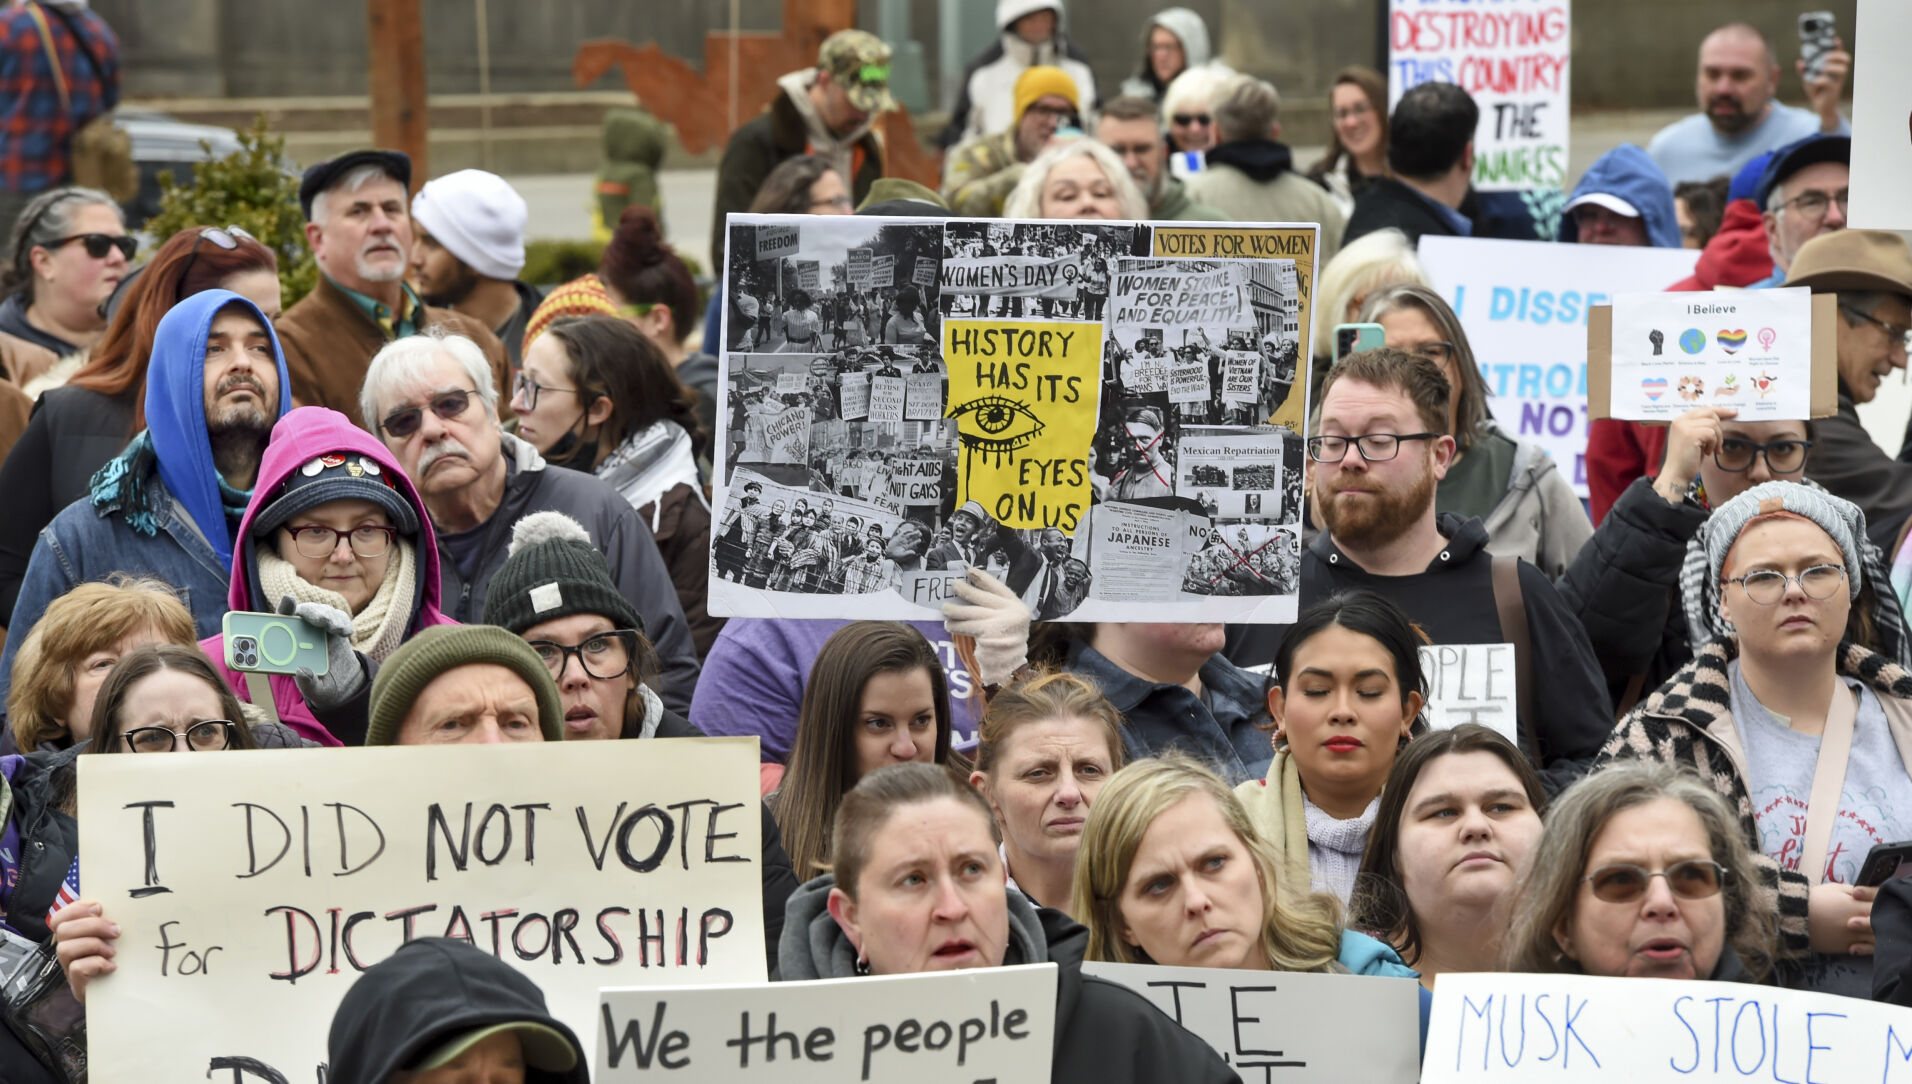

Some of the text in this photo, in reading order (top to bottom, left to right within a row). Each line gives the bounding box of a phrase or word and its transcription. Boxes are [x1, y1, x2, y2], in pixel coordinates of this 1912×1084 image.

[1391, 8, 1566, 51] DESTROYING
[1459, 53, 1568, 94] COUNTRY
[1494, 102, 1549, 140] THE
[1474, 146, 1566, 187] NAIRES
[759, 233, 798, 252] FREEDOM
[1159, 234, 1311, 255] VOTES FOR WOMEN
[942, 264, 1018, 287] WOMEN'S
[1024, 264, 1058, 286] DAY
[1117, 271, 1230, 297] WOMEN STRIKE
[1135, 292, 1173, 306] FOR
[1694, 304, 1736, 315] Believe
[1117, 307, 1147, 323] AND
[951, 328, 1075, 358] HISTORY
[976, 361, 1082, 404] HAS ITS
[1170, 366, 1203, 377] SISTERHOOD
[1229, 367, 1253, 375] VIETNAM
[1239, 375, 1253, 383] OUR
[1226, 383, 1252, 392] SISTERS
[872, 396, 902, 404] SECOND
[766, 410, 805, 435] CHICANO
[869, 411, 899, 420] WORKERS
[1519, 402, 1588, 438] NO
[769, 421, 805, 445] POWER!
[1183, 446, 1280, 457] Mexican Repatriation
[915, 461, 941, 477] AIDS
[1019, 458, 1086, 488] EYES
[889, 482, 939, 499] NOT GAYS
[873, 496, 900, 516] FEAR
[996, 491, 1035, 522] ON
[1042, 503, 1081, 532] US
[1107, 532, 1171, 548] JAPANESE
[1189, 525, 1211, 538] NO
[914, 576, 968, 603] FRE
[123, 799, 752, 898] I DID NOT VOTE
[264, 904, 734, 984] DICTATORSHIP
[601, 999, 1031, 1082] We the people
[1456, 993, 1601, 1071] MUSK
[1670, 996, 1848, 1084] STOLE
